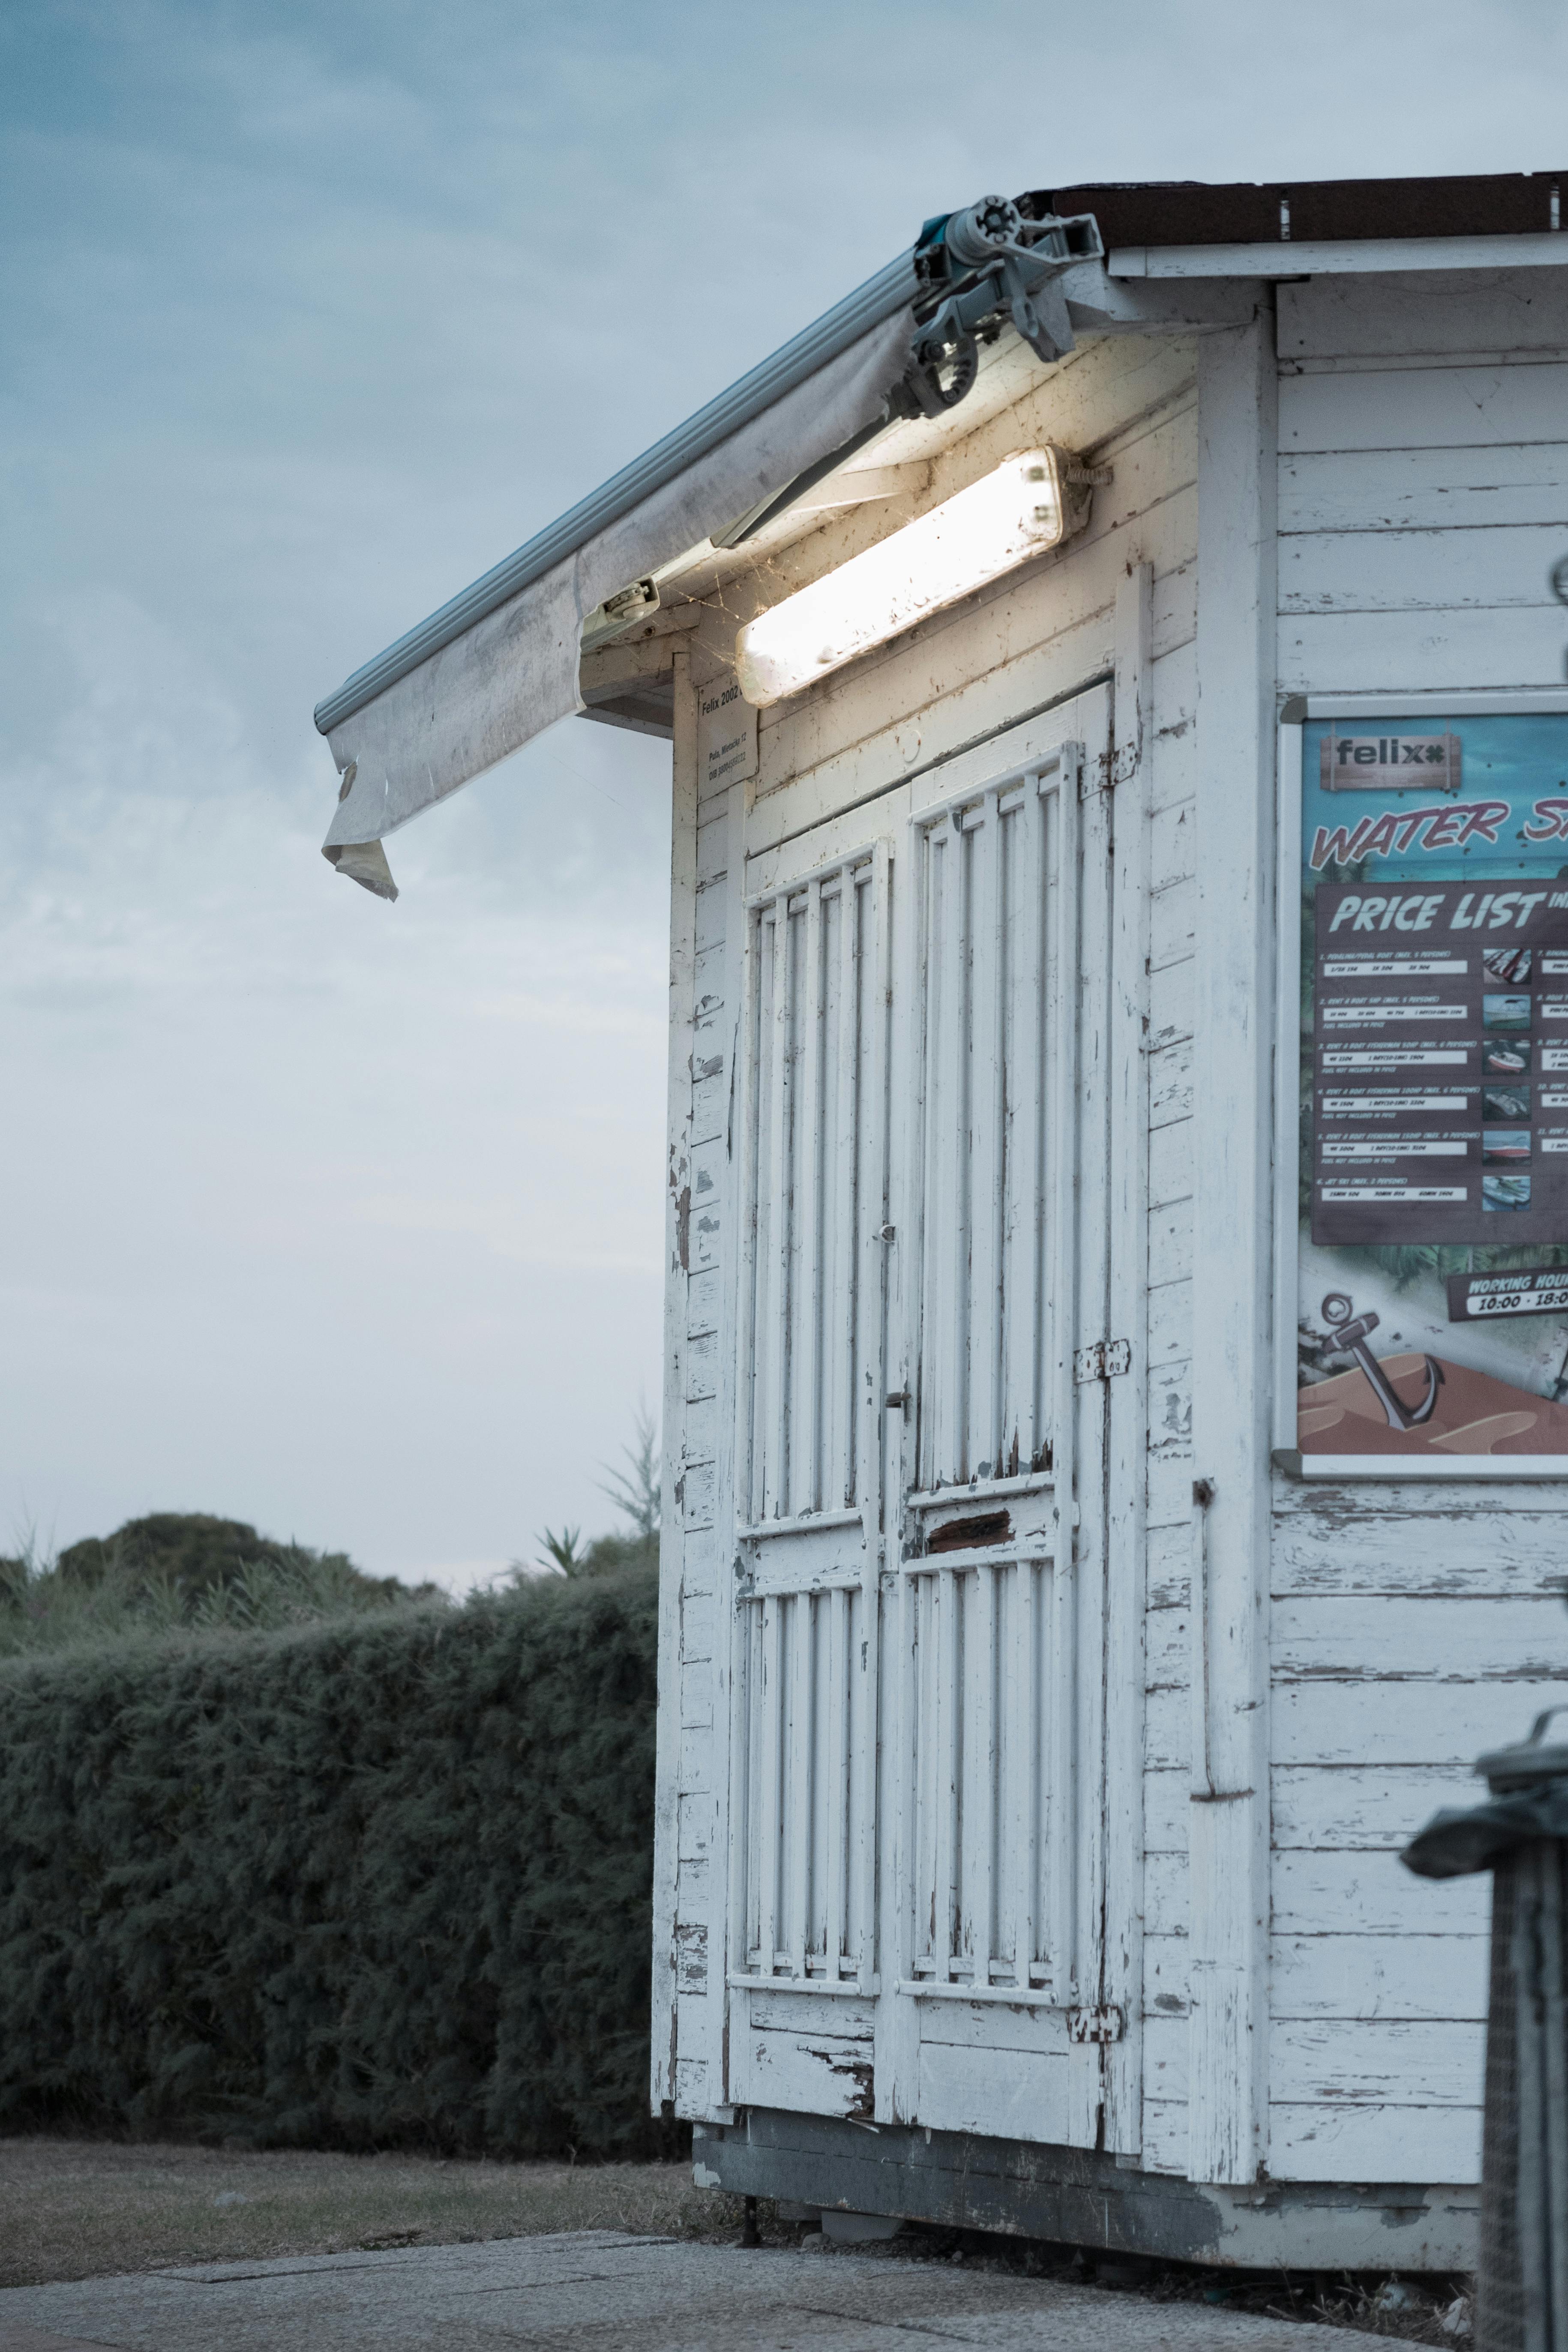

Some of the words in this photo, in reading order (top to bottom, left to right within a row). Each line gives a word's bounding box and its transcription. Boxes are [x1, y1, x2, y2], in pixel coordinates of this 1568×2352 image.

[702, 698, 719, 716] Felix
[721, 686, 738, 706] 2002
[741, 732, 747, 742] 12
[1309, 800, 1511, 871] WATER
[1329, 894, 1445, 933] PRICE
[1450, 892, 1547, 930] LIST
[1469, 1275, 1532, 1294] WORKING
[1479, 1296, 1521, 1311] 10:00
